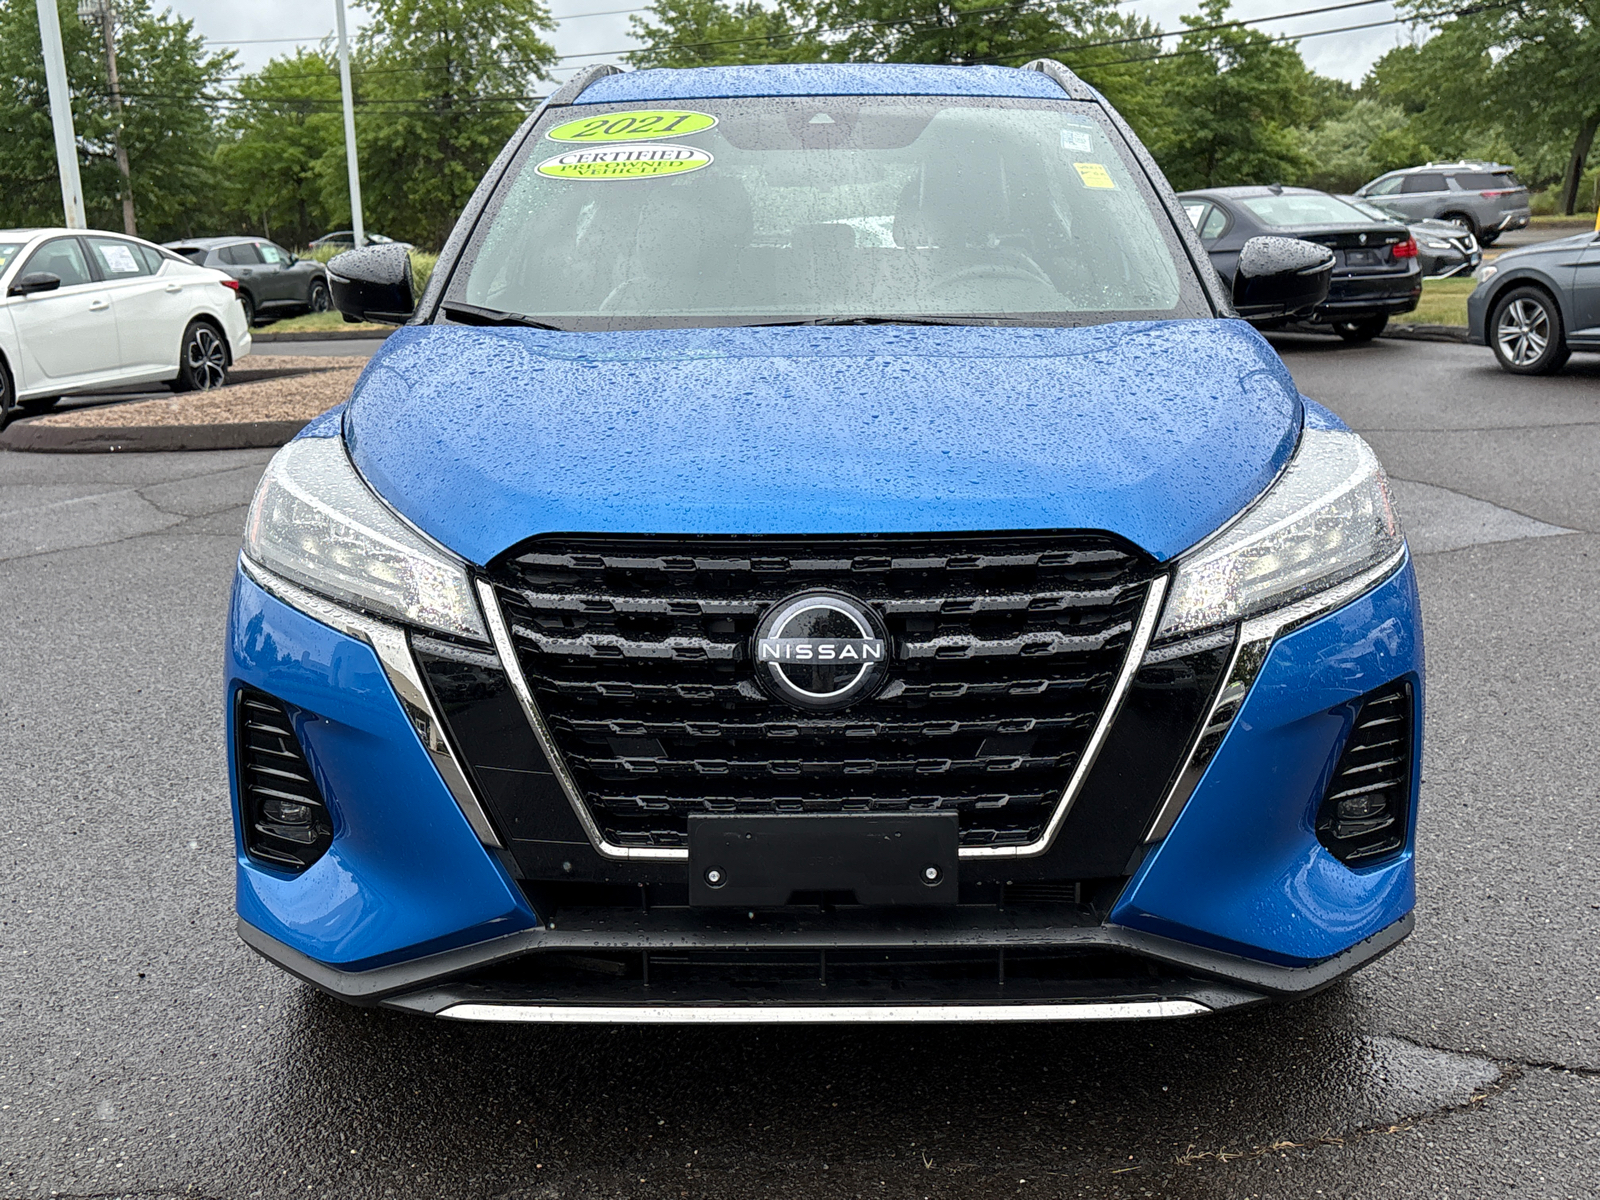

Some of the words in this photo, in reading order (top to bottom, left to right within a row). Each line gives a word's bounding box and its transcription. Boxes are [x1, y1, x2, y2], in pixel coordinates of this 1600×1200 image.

[571, 115, 691, 138] 2021
[559, 150, 694, 165] CERTIFIED
[560, 160, 684, 172] PRE-OWNED
[577, 167, 663, 176] VEHICLE
[763, 643, 880, 659] NISSAN
